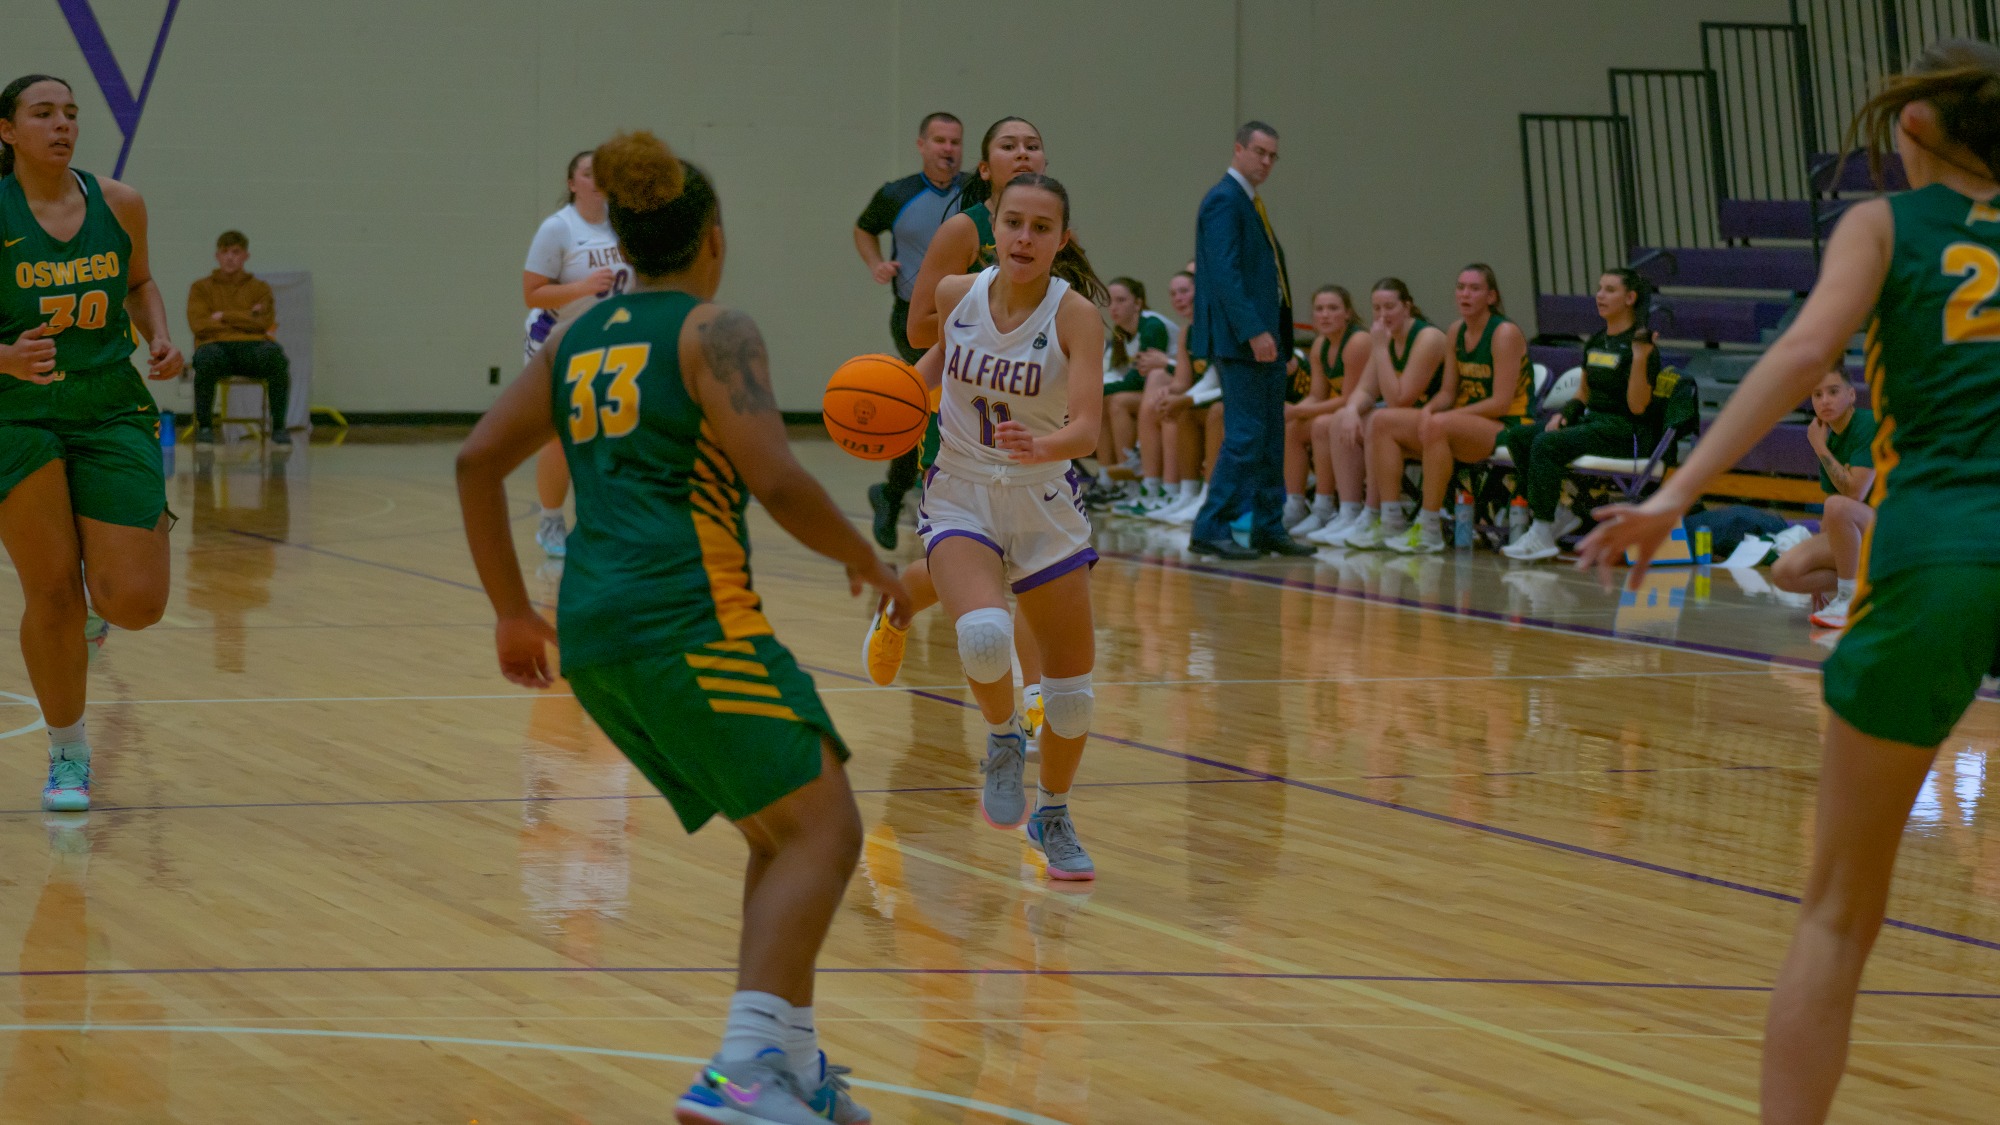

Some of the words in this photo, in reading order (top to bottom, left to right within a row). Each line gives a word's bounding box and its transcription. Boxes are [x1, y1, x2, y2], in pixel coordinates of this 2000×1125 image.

[16, 251, 119, 289] OSWEGO
[588, 246, 625, 268] ALFR
[39, 290, 108, 336] 30
[1941, 241, 2000, 345] 2
[566, 343, 651, 444] 33
[947, 344, 1042, 397] ALFRED
[842, 438, 884, 453] EVO
